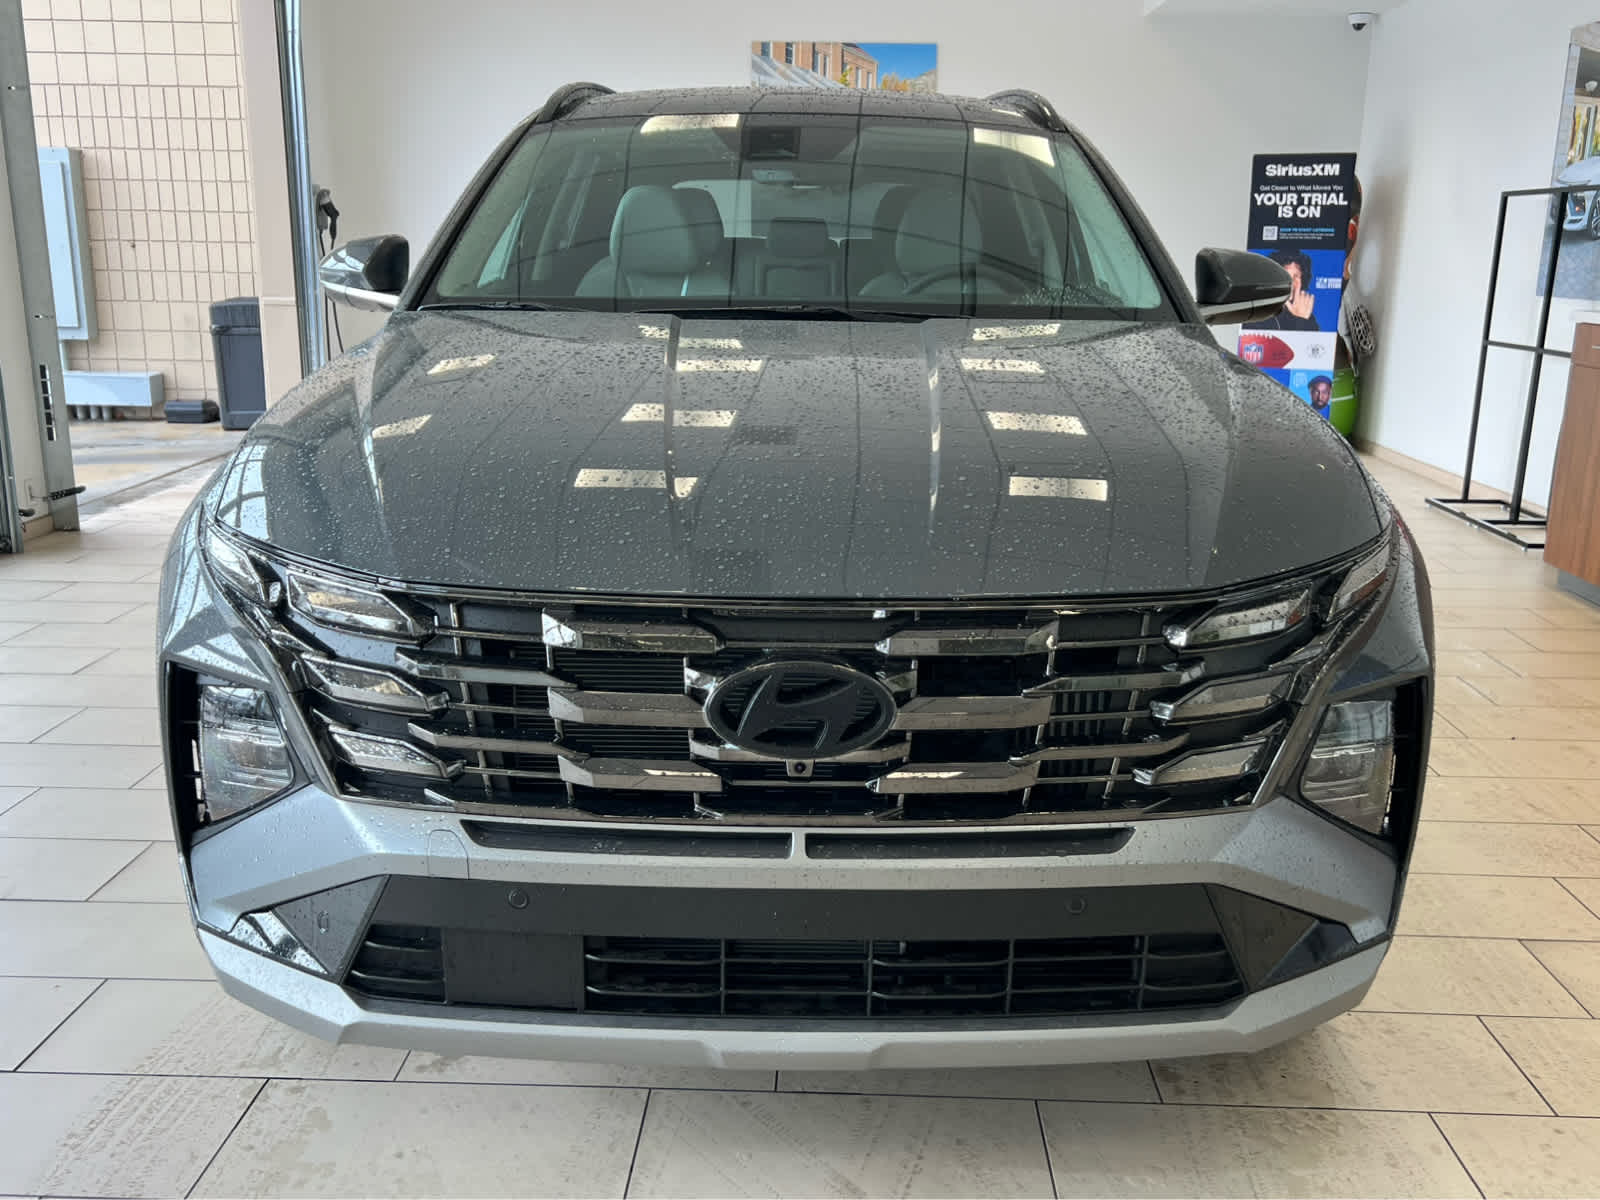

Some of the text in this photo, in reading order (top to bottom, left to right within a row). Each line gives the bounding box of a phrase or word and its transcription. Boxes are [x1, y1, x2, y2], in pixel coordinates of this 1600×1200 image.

[1265, 163, 1340, 177] SiriusXM
[1254, 192, 1348, 206] YOUR TRIAL
[1277, 206, 1321, 218] IS ON
